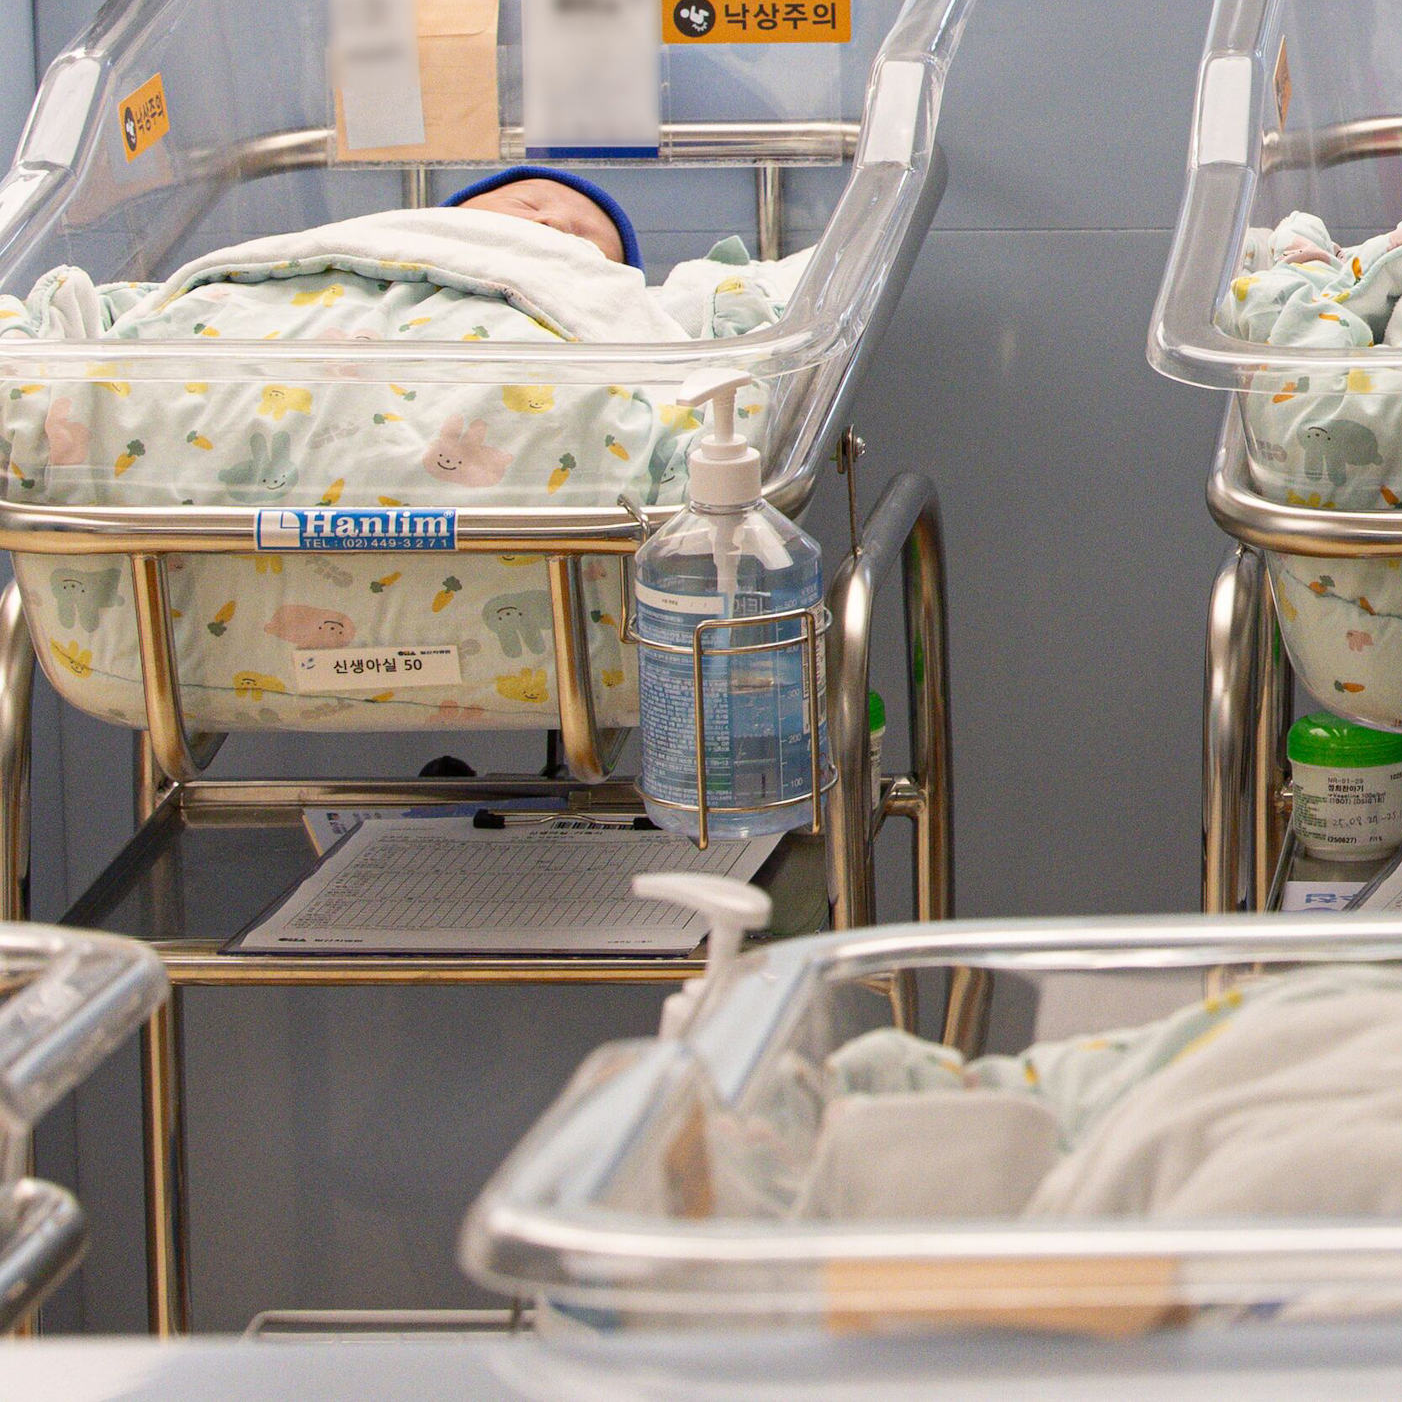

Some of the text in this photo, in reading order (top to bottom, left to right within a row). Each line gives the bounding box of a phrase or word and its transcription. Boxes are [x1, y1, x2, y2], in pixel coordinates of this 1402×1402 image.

[724, 2, 836, 30] 낙상주의
[302, 510, 450, 537] Hanlim
[342, 538, 368, 549] (02)
[333, 658, 422, 674] 신생아실 50
